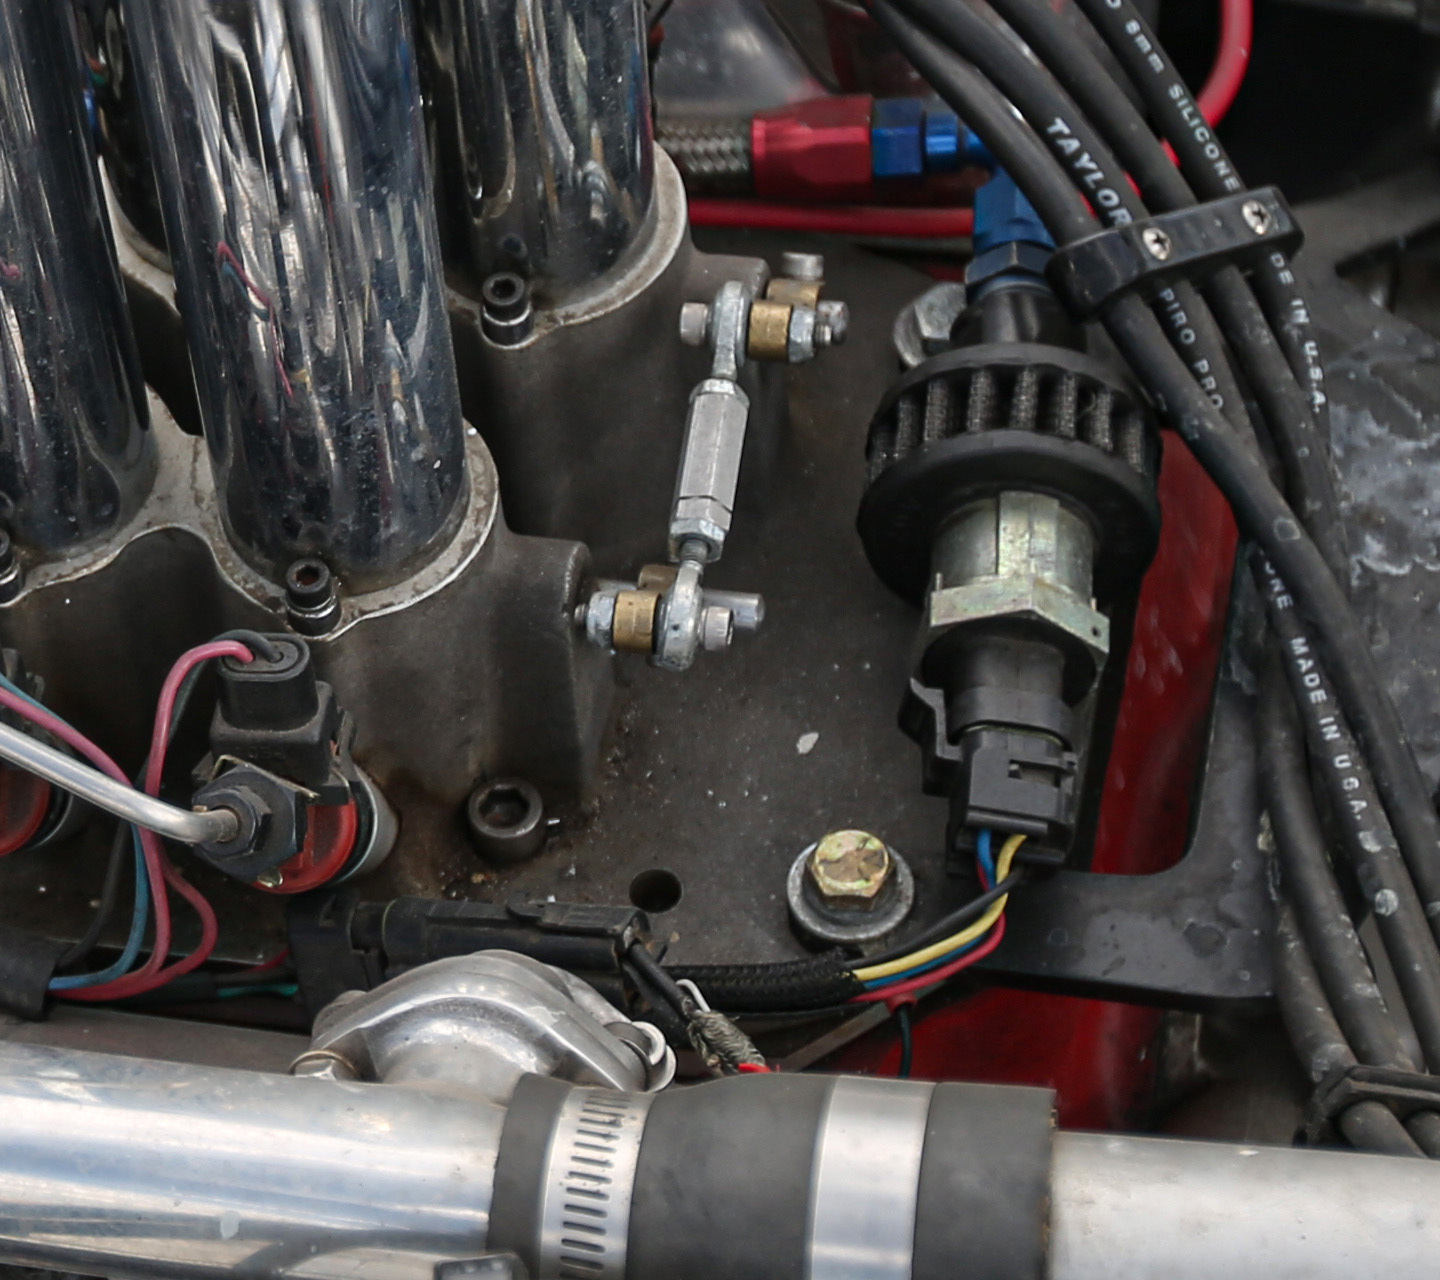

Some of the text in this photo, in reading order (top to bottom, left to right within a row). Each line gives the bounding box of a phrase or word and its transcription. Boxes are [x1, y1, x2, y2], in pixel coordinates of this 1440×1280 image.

[1125, 19, 1166, 76] 8mm
[1166, 83, 1242, 192] SILICONE
[1045, 116, 1227, 414] TAYLOR PIRO PRO
[1269, 250, 1328, 417] DE IN U.S.A.
[1289, 635, 1329, 709] MADE
[1317, 712, 1342, 742] IN
